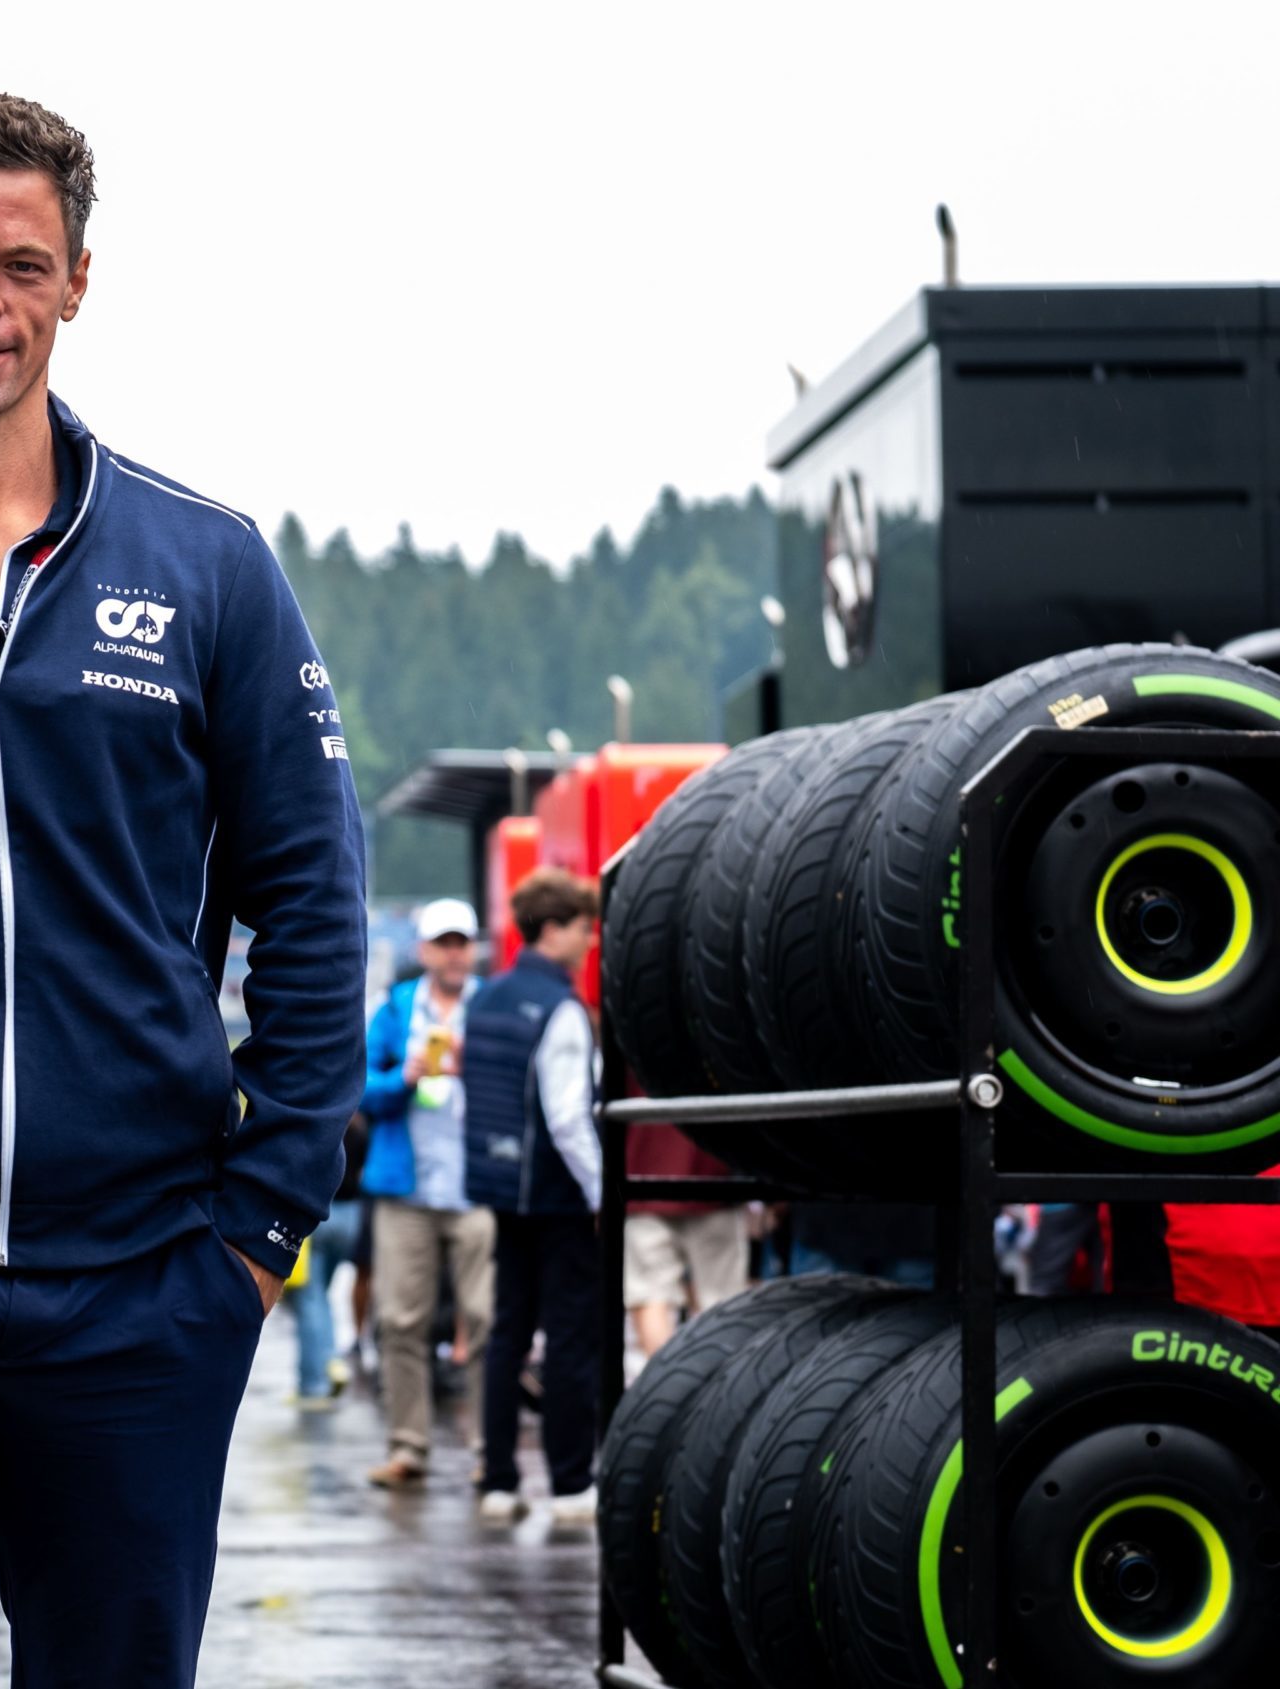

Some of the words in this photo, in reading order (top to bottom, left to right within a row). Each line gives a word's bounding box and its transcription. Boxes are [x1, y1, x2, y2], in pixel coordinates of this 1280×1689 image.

[97, 583, 166, 600] SCUDERIA
[93, 640, 165, 665] ALPHATAURI
[81, 670, 180, 705] HONDA
